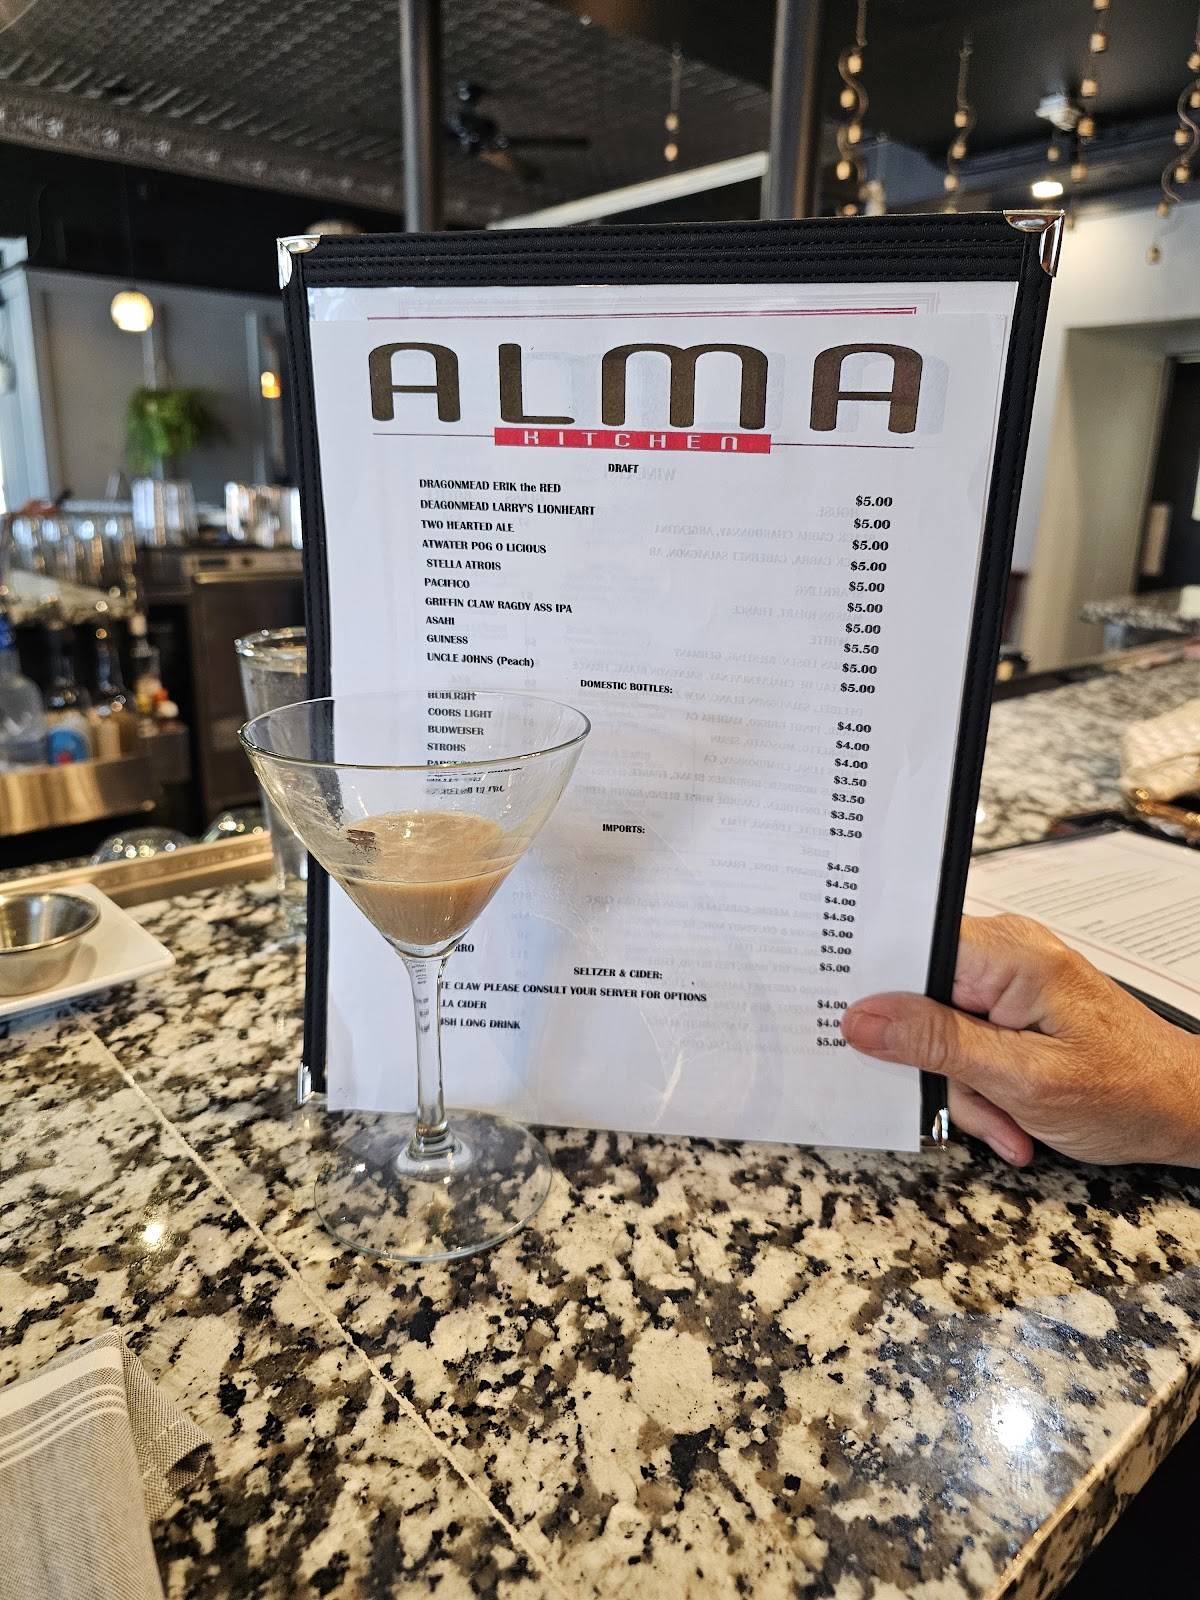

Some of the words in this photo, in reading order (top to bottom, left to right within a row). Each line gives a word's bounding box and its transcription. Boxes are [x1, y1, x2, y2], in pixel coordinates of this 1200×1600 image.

[368, 341, 923, 434] ALMA
[524, 431, 739, 450] KITCHEN
[608, 463, 640, 474] DRAFT
[419, 479, 490, 490] DRAGONMEAD
[493, 481, 517, 492] ERIK
[520, 482, 537, 493] the
[539, 483, 562, 493] RED
[855, 494, 893, 507] $5.00
[420, 499, 490, 511] DEAGONMEAD
[537, 503, 595, 516] LIONHEART
[420, 519, 444, 529] TWO
[446, 520, 493, 531] HEARTED
[495, 522, 515, 533] ALE
[853, 517, 891, 530] $5.00
[422, 539, 468, 550] ATWATER
[471, 541, 493, 551] POG
[495, 542, 504, 552] O
[506, 543, 547, 554] LICIOUS
[851, 539, 889, 551] $5.00
[426, 558, 463, 569] STELLA
[465, 560, 502, 571] ATROIS
[850, 560, 887, 572] $5.00
[424, 577, 471, 589] PACIFICO
[848, 580, 885, 593] $5.00
[425, 597, 464, 608] GRIFFIN
[467, 599, 495, 609] CLAW
[497, 600, 531, 611] RAGDY
[533, 602, 553, 613] ASS
[555, 603, 573, 614] IPA
[846, 602, 883, 614] $5.00
[425, 616, 455, 626] ASAHI
[845, 622, 881, 635] $5.00
[426, 634, 469, 645] GUINESS
[843, 642, 880, 655] $5.50
[426, 652, 459, 663] UNCLE
[461, 654, 494, 665] JOHNS
[496, 656, 535, 669] (Peach)
[841, 662, 878, 675] $5.00
[580, 679, 627, 690] DOMESTIC
[629, 682, 673, 694] BOTTLES:
[840, 682, 876, 694] $5.00
[427, 707, 462, 717] COORS
[464, 709, 493, 719] LIGHT
[427, 725, 484, 736] BUDWEISER
[837, 721, 872, 734] $4.00
[427, 742, 466, 752] STROHS
[835, 740, 870, 752] $4.00
[834, 758, 869, 770] $4.00
[833, 775, 867, 788] $3.50
[831, 792, 865, 805] $3.50
[830, 810, 864, 822] $3.50
[602, 823, 646, 834] IMPORTS:
[829, 827, 863, 839] $3.50
[827, 862, 860, 874] $4.50
[825, 879, 858, 891] $4.50
[824, 895, 857, 907] $4.00
[823, 911, 855, 923] $4.50
[822, 928, 854, 939] $5.00
[820, 944, 852, 955] $5.00
[573, 967, 616, 977] SELTZER
[618, 969, 626, 978] &
[629, 969, 663, 980] CIDER:
[819, 962, 851, 974] $5.00
[453, 981, 481, 991] CLAW
[483, 983, 520, 993] PLEASE
[522, 984, 566, 995] CONSULT
[570, 986, 597, 996] YOUR
[599, 988, 638, 998] SERVER
[640, 990, 661, 999] FOR
[663, 991, 707, 1002] OPTIONS
[457, 999, 487, 1009] CIDER
[816, 999, 848, 1010] $4.00
[460, 1018, 487, 1028] LONG
[489, 1019, 521, 1030] DRINK
[816, 1016, 841, 1028] $4.0
[816, 1036, 848, 1048] $5.00
